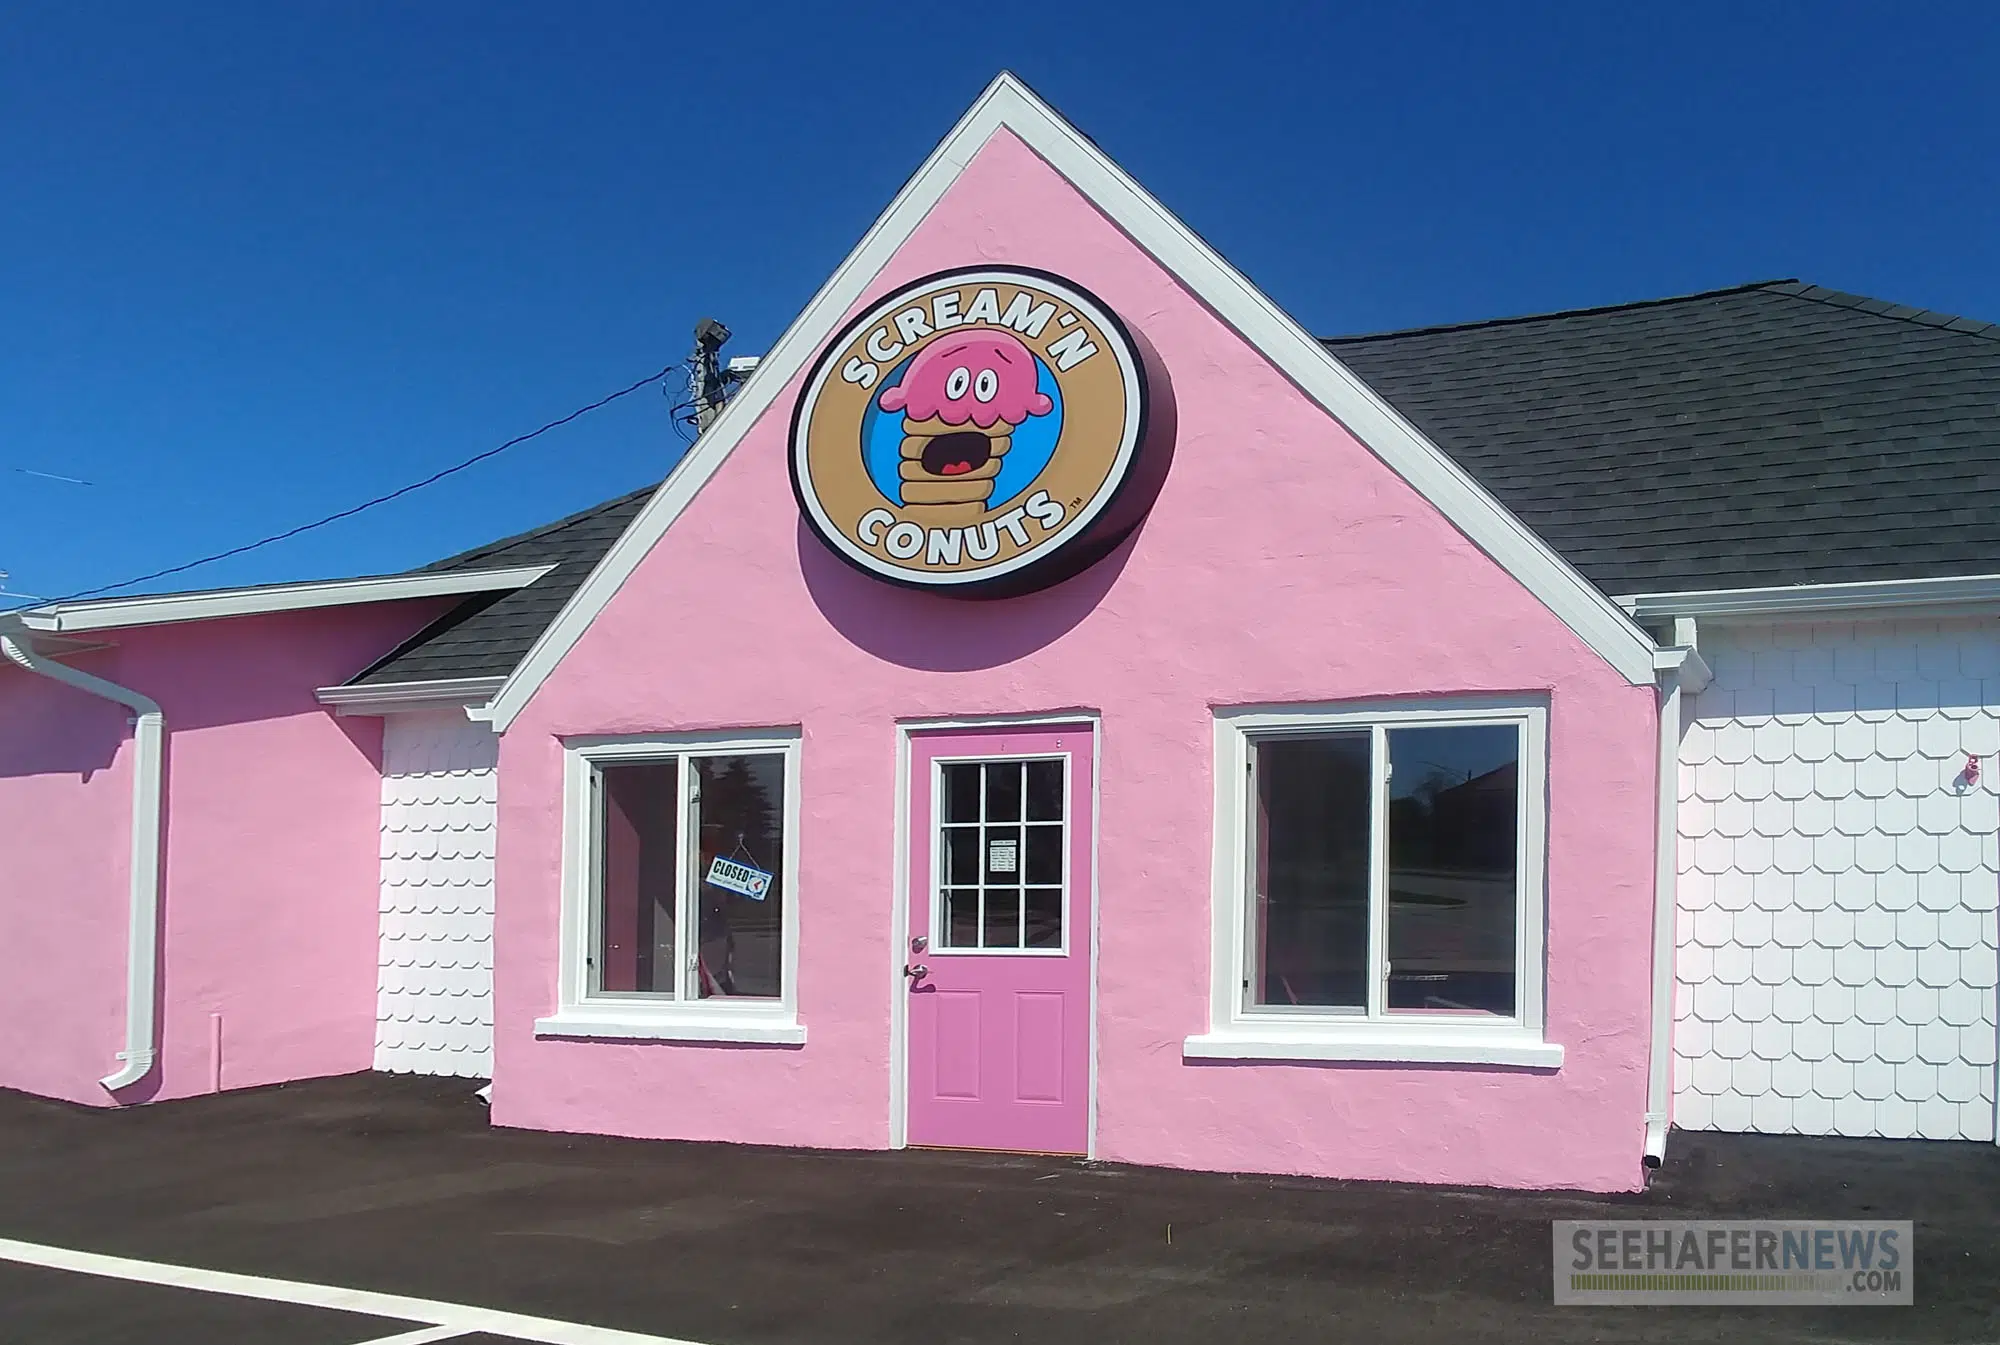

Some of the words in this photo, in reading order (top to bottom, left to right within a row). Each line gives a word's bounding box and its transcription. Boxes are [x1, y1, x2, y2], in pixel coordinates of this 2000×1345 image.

[842, 288, 1099, 389] SCREAM'N
[857, 490, 1065, 565] CONUTS
[713, 860, 750, 883] CLOSED
